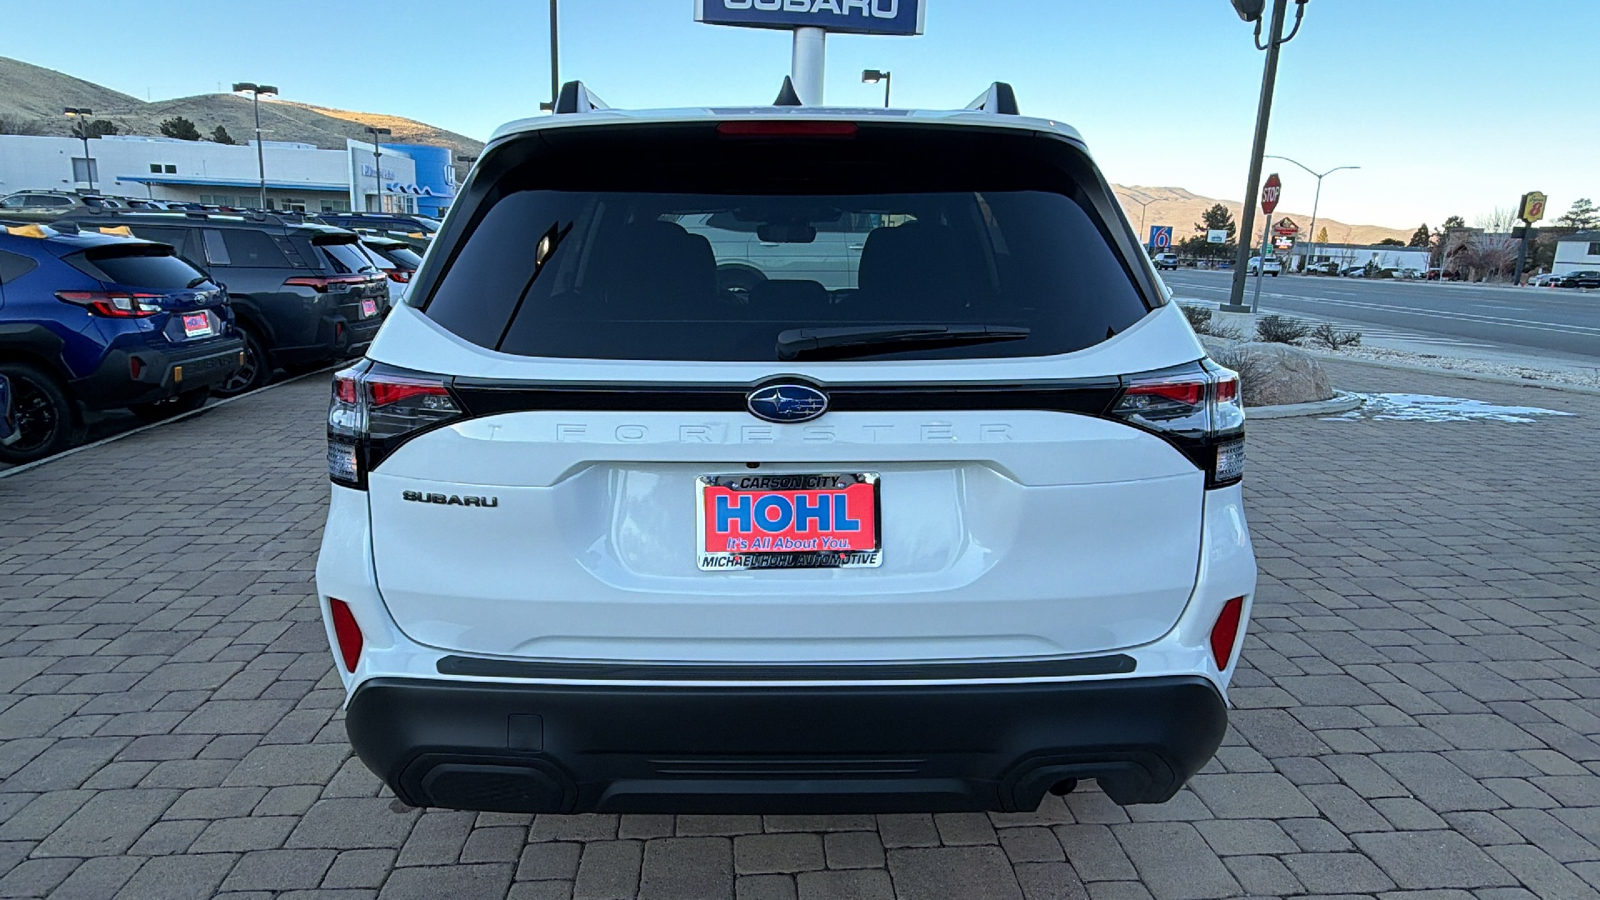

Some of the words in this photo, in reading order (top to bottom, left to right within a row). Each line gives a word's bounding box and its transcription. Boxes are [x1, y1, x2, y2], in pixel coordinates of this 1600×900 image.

[1263, 187, 1280, 202] STOP
[1529, 201, 1543, 216] 8
[1154, 227, 1170, 248] 6
[556, 423, 1012, 443] FORESTER
[740, 477, 801, 489] CARSON
[806, 476, 840, 487] CITY
[402, 490, 498, 507] SUBARU
[715, 494, 860, 533] HOHL
[727, 538, 748, 550] It's
[752, 537, 771, 549] All
[774, 537, 818, 549] About
[821, 536, 850, 549] You.
[702, 555, 757, 568] MICHAEL
[797, 553, 877, 566] AUTOMOTIVE
